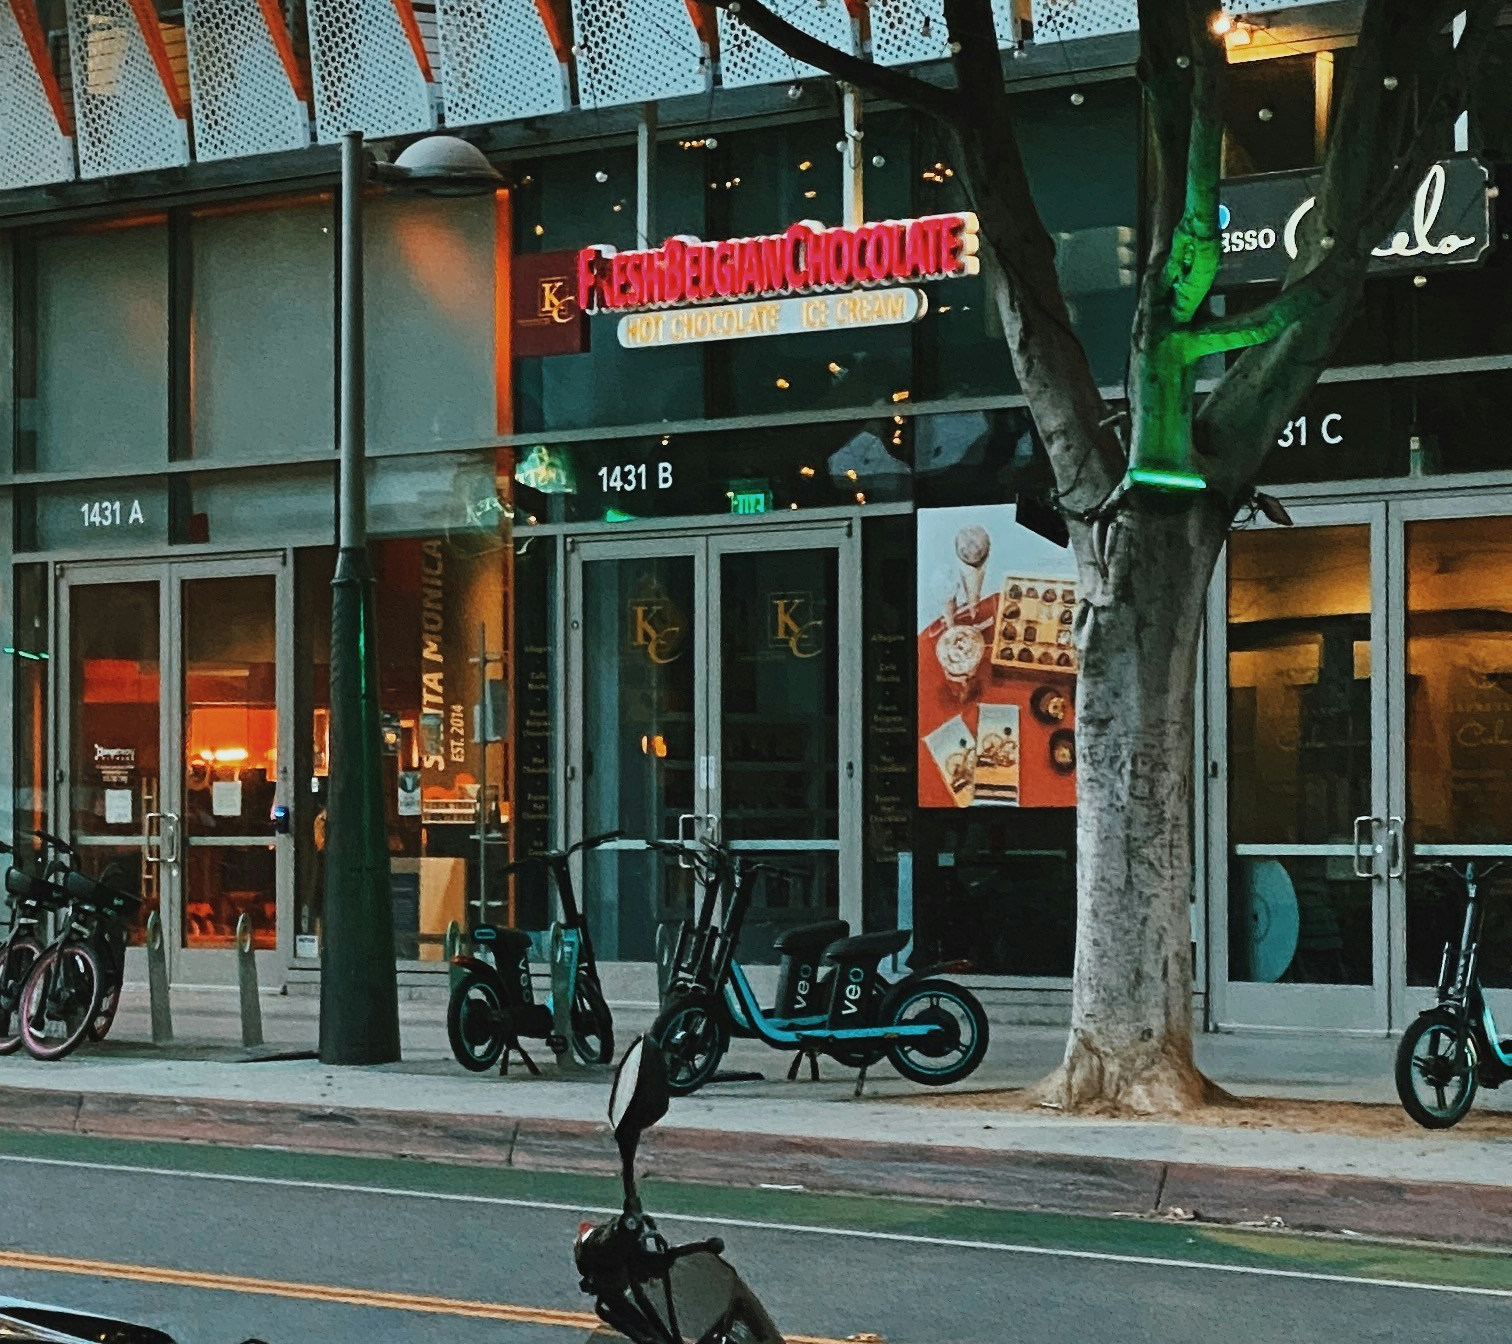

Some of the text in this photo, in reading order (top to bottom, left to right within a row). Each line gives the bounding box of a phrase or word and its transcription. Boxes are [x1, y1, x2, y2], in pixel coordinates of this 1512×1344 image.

[579, 215, 966, 310] FRESH BELGIAN CHOCOLATE
[627, 293, 906, 344] HOT CHOCOLATE ICE CREAM
[1321, 412, 1343, 445] C
[597, 461, 674, 493] 1431 B
[80, 499, 145, 527] 1431 A
[421, 538, 445, 664] MONICA
[450, 703, 465, 763] EST. 2014
[793, 963, 813, 1010] veo
[841, 967, 865, 1015] veo
